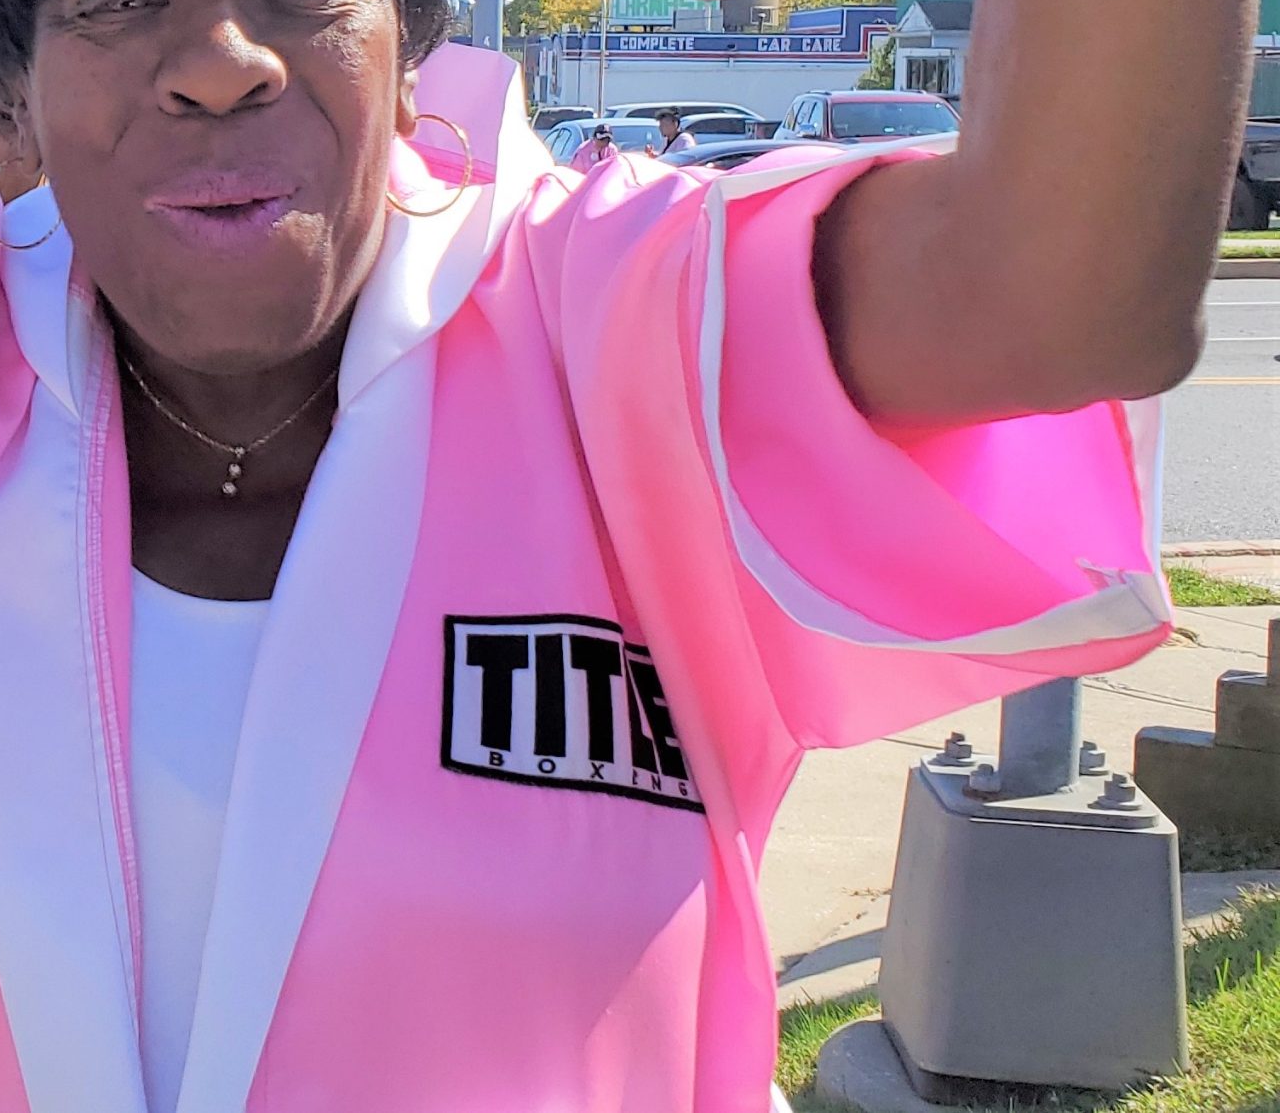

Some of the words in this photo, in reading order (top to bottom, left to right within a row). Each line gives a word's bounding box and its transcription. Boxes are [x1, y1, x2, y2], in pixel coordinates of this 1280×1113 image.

[619, 37, 695, 50] COMPLETE
[757, 38, 791, 52] CAR
[802, 38, 842, 52] CARE
